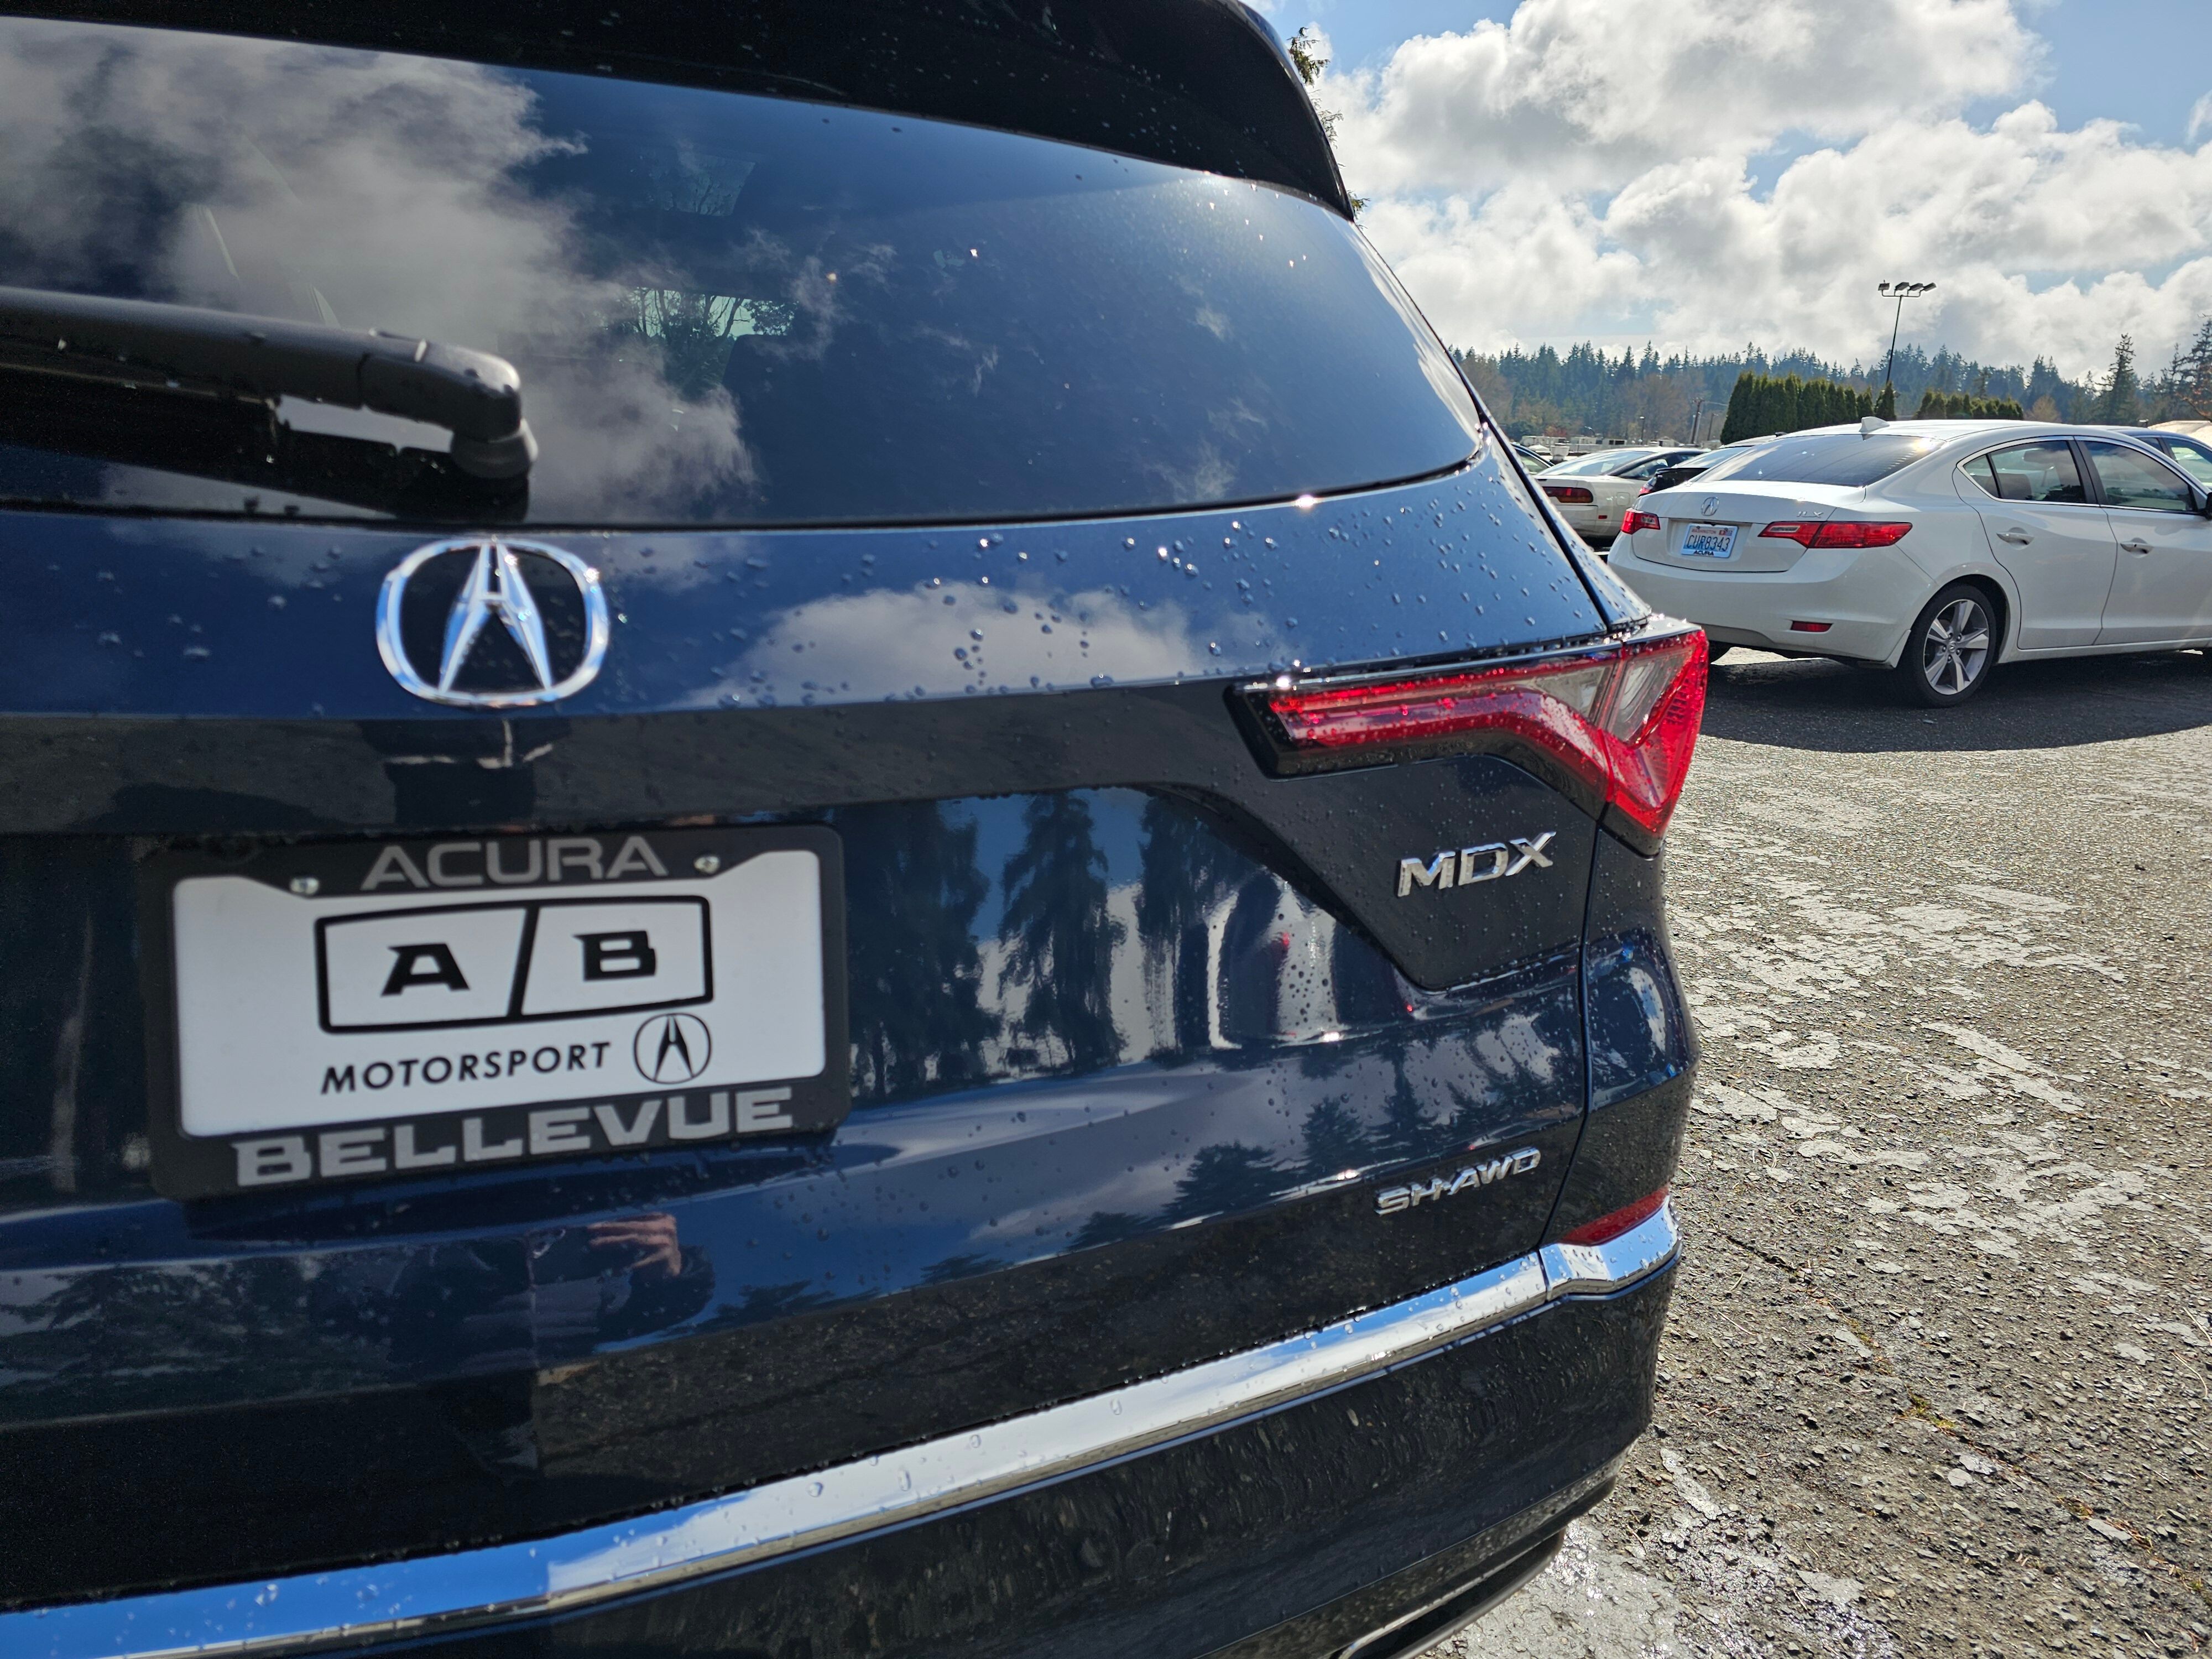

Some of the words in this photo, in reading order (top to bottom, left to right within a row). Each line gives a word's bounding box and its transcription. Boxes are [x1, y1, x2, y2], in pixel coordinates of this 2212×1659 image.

[1687, 535, 1730, 551] CUR8343
[361, 836, 669, 891] ACURA
[1397, 831, 1557, 897] MDX
[380, 942, 470, 997] A
[572, 930, 658, 982] B
[320, 1041, 612, 1094] MOTORSPORT
[231, 1087, 794, 1187] BELLEVUE
[1374, 1146, 1541, 1216] SH-AWD
